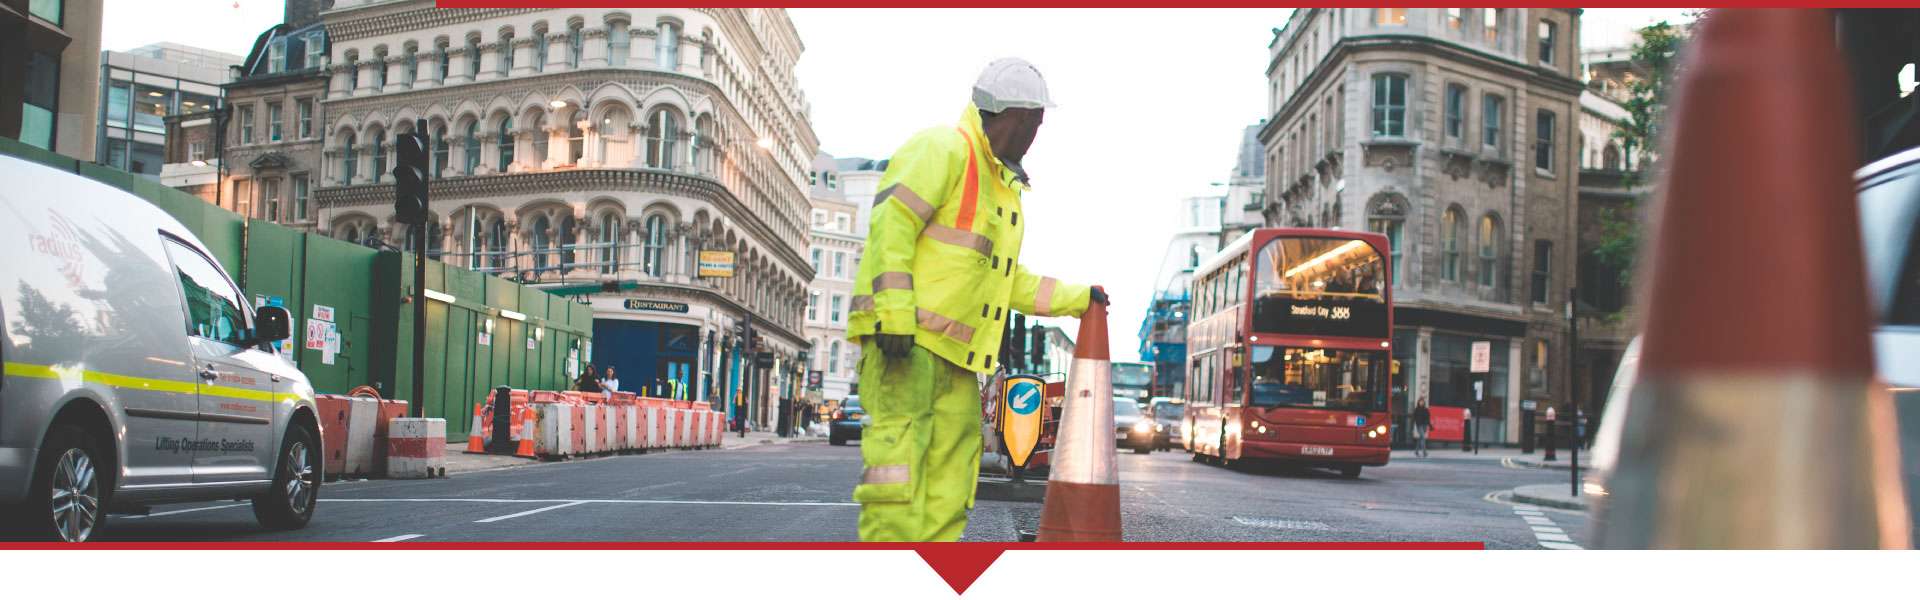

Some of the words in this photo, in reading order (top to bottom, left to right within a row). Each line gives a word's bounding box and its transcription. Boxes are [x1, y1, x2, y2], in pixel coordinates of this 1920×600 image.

[29, 231, 82, 262] radius
[1317, 305, 1329, 319] City
[1331, 305, 1350, 319] 388
[155, 436, 180, 454] Lifting
[181, 437, 219, 454] Operations
[220, 438, 255, 455] Specialists
